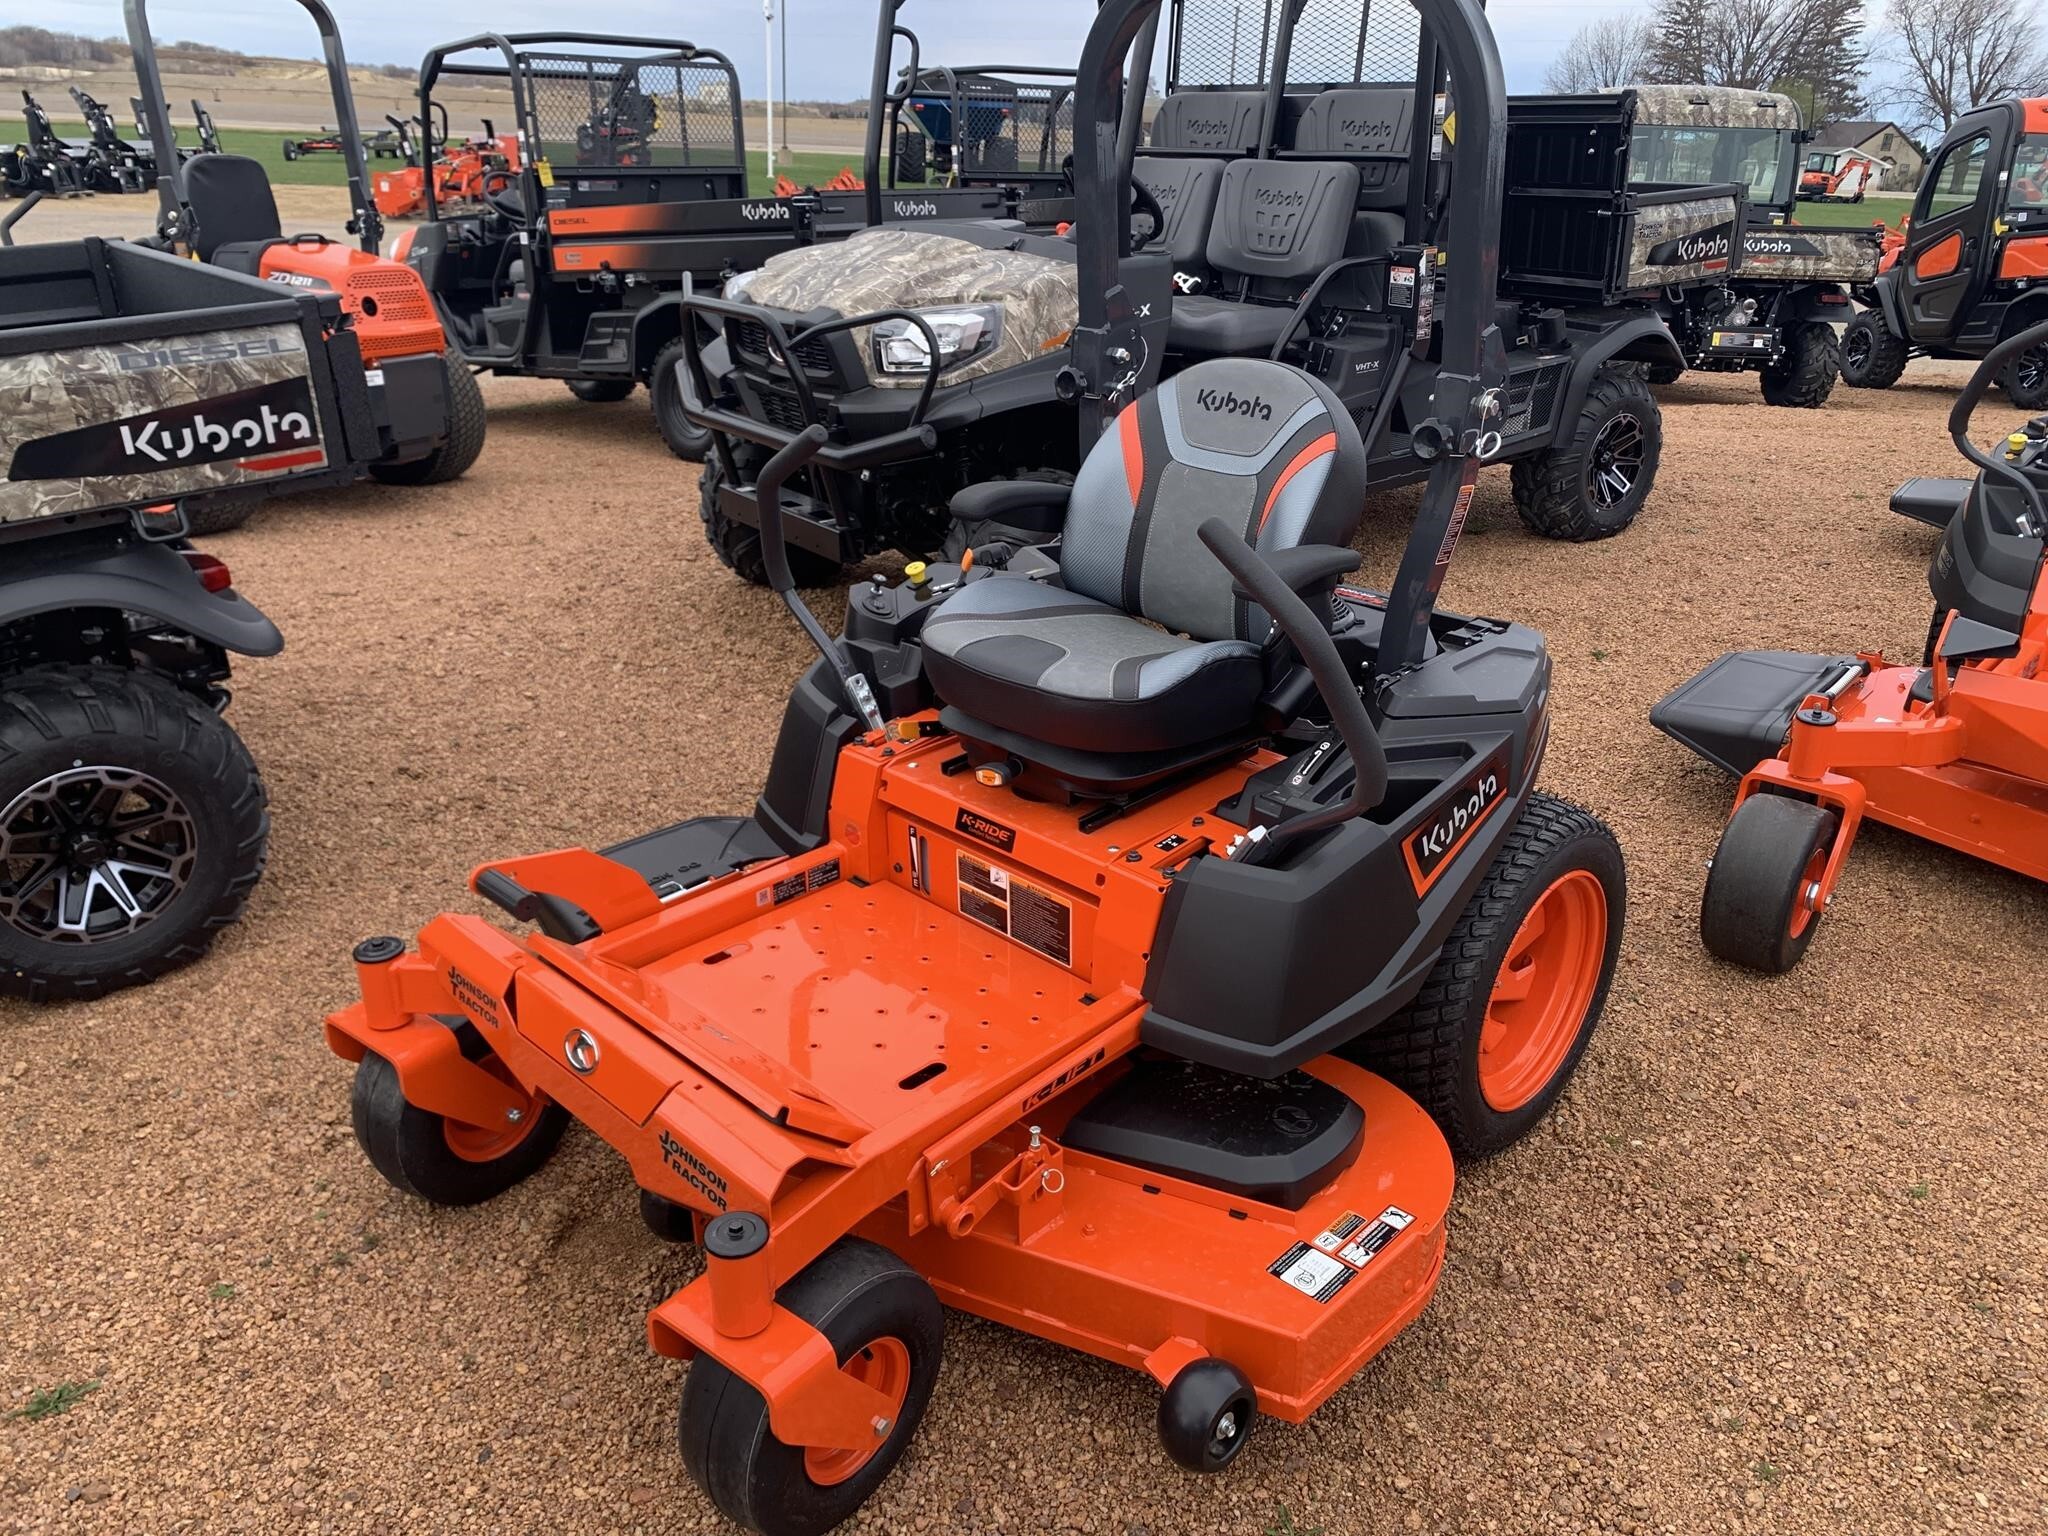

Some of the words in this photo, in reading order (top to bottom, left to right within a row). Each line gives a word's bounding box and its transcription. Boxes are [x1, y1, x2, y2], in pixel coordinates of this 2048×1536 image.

[1187, 119, 1230, 137] Kubota
[1341, 119, 1392, 138] Kubota
[742, 203, 790, 221] Kubota
[894, 200, 937, 217] Kubota
[1256, 188, 1304, 208] Kubota
[1677, 234, 1729, 261] Kubota
[1743, 239, 1792, 253] Kubota
[117, 338, 301, 370] DIESEL
[1355, 360, 1380, 372] VHT-X
[1196, 388, 1273, 421] Kubota
[119, 404, 312, 462] Kubota
[961, 813, 1011, 842] K-RIDE
[1421, 774, 1498, 857] Kubota
[448, 965, 498, 1012] JOHNSON
[450, 982, 499, 1029] TRACTOR
[1025, 1047, 1104, 1110] K-LIFT
[659, 1130, 728, 1193] JOHNSON
[660, 1144, 728, 1211] TRACTOR
